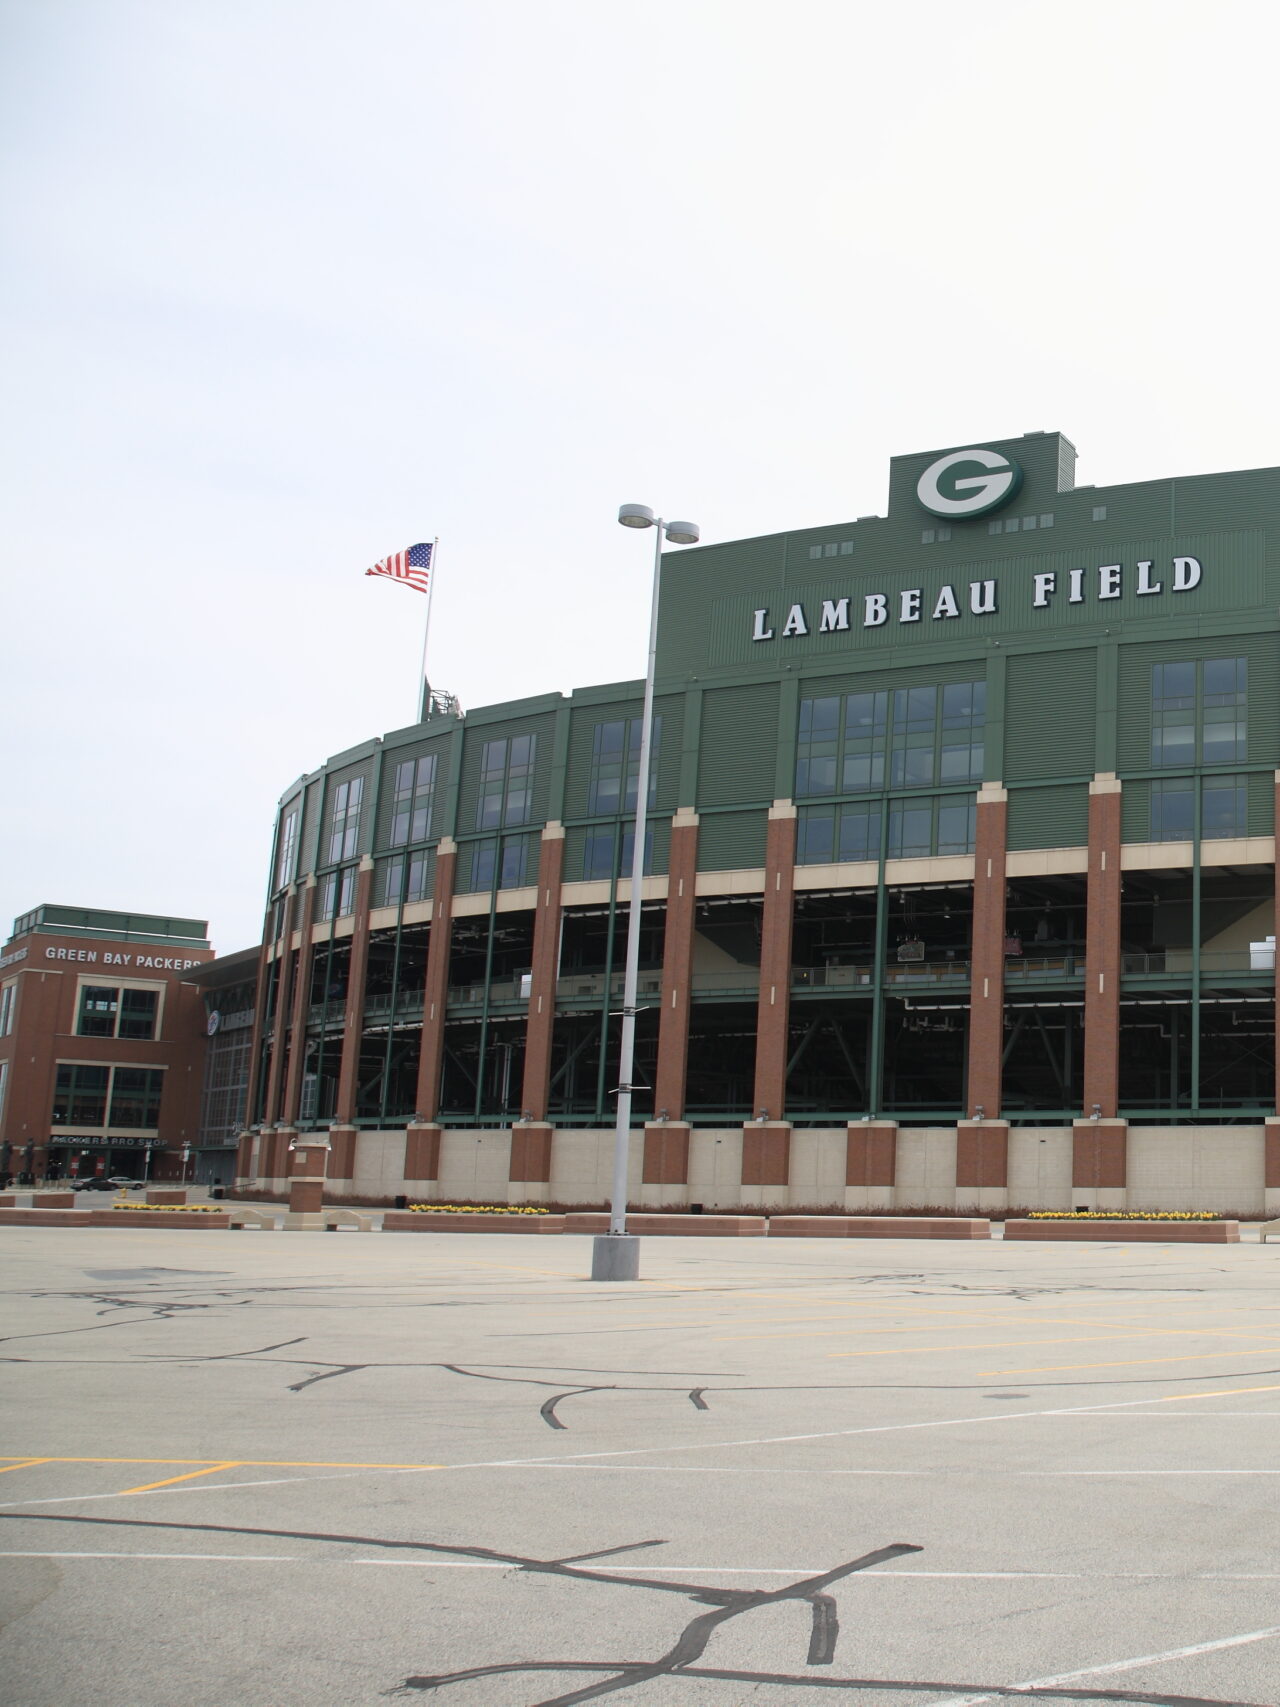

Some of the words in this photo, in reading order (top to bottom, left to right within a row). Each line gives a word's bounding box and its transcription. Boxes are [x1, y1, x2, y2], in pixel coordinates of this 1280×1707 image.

[917, 449, 1013, 513] G
[752, 579, 998, 641] LAMBEAU
[1033, 556, 1202, 607] FIELD
[45, 947, 97, 963] GREEN
[103, 952, 132, 966] BAY
[52, 1135, 109, 1145] PACKERS
[111, 1137, 134, 1146] PRO
[137, 1138, 168, 1146] SHOP
